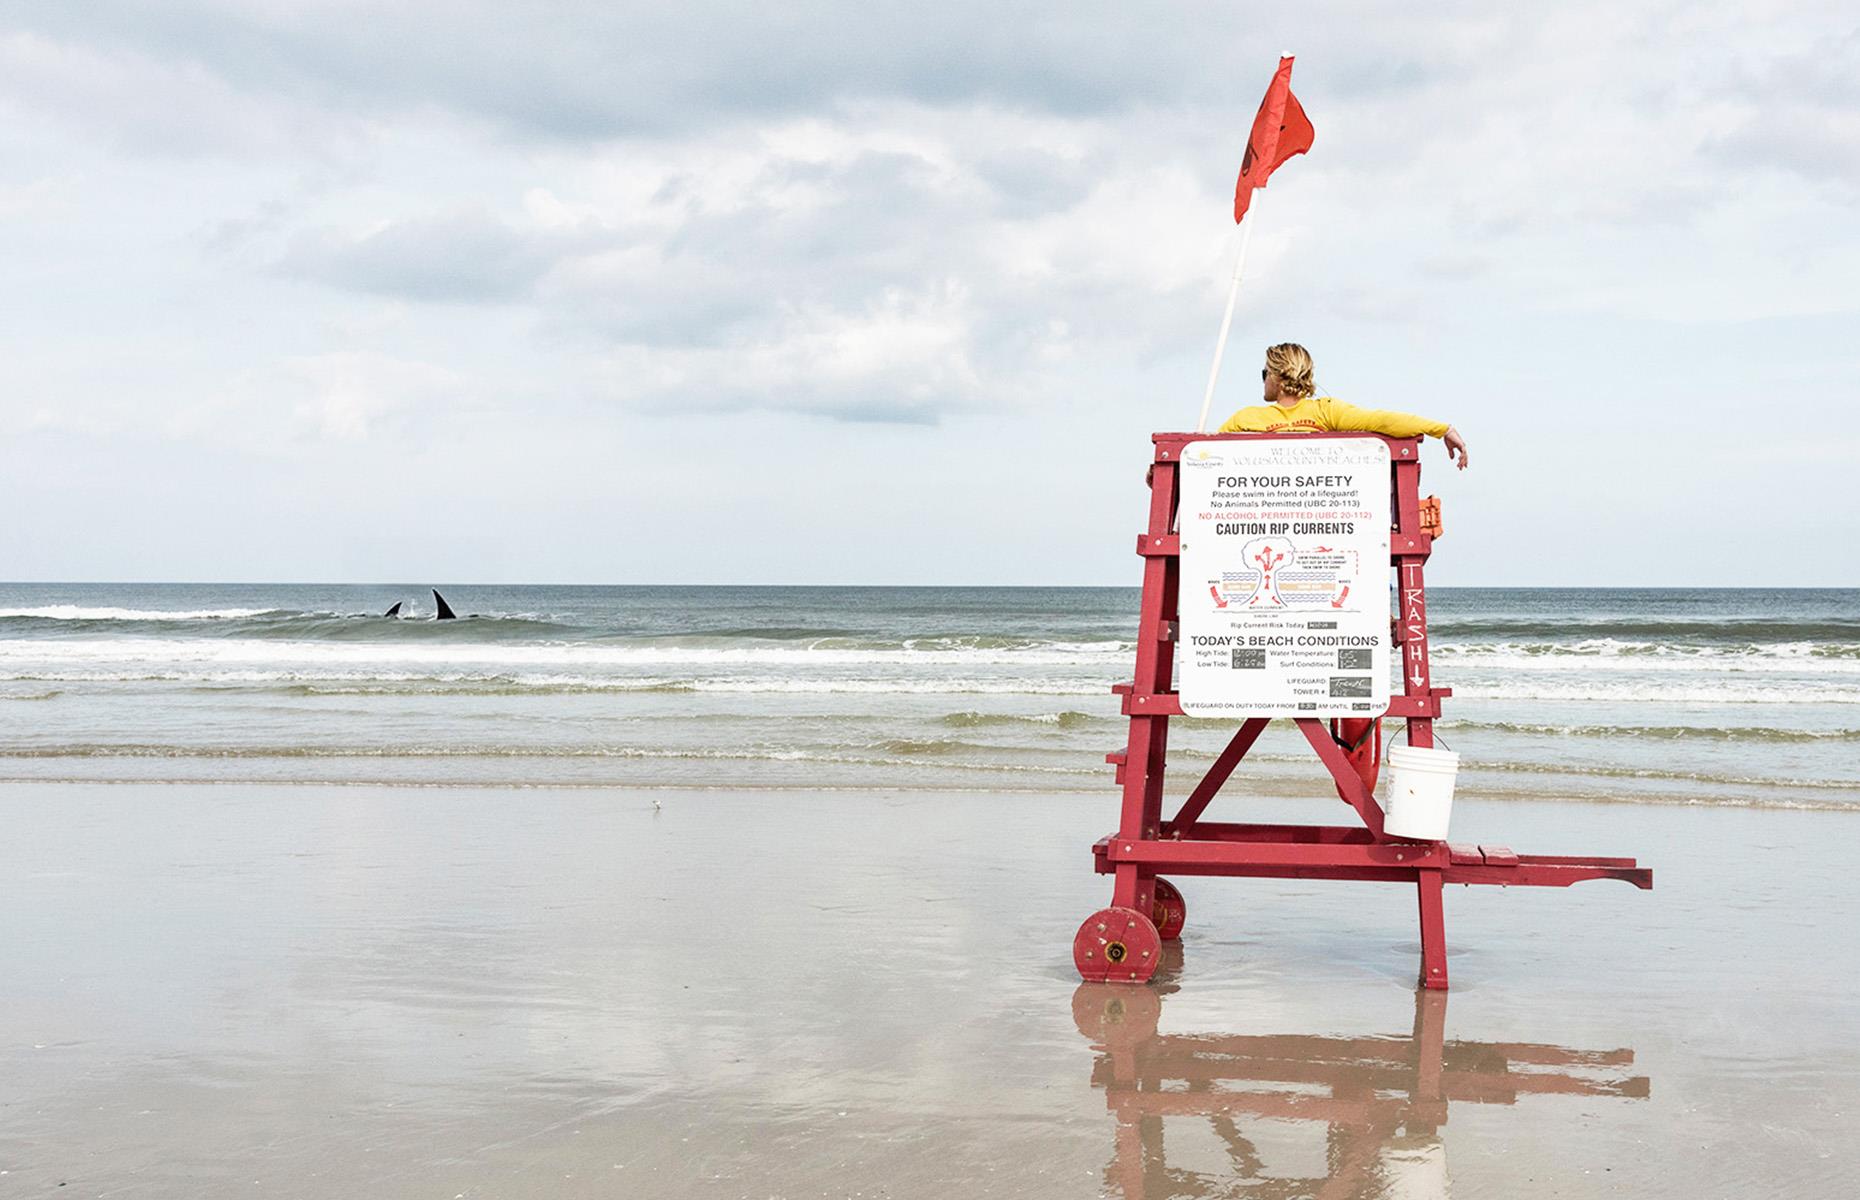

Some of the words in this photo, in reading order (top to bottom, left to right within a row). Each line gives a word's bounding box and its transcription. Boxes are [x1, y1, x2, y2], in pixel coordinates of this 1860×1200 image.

[1218, 477, 1247, 487] FOR
[1251, 476, 1290, 487] YOUR
[1296, 476, 1352, 487] SAFETY
[1318, 490, 1358, 498] lifeguard!
[1304, 500, 1326, 508] (UBC
[1199, 512, 1212, 520] NO
[1215, 512, 1258, 520] ALCOHOL
[1315, 512, 1337, 520] (UBC
[1216, 523, 1266, 535] CAUTION
[1270, 523, 1289, 534] RIP
[1293, 523, 1353, 534] CURRENTS
[1402, 563, 1424, 661] TRASH
[1191, 636, 1245, 646] TODAY'S
[1249, 636, 1293, 646] BEACH
[1298, 636, 1378, 646] CONDITIONS
